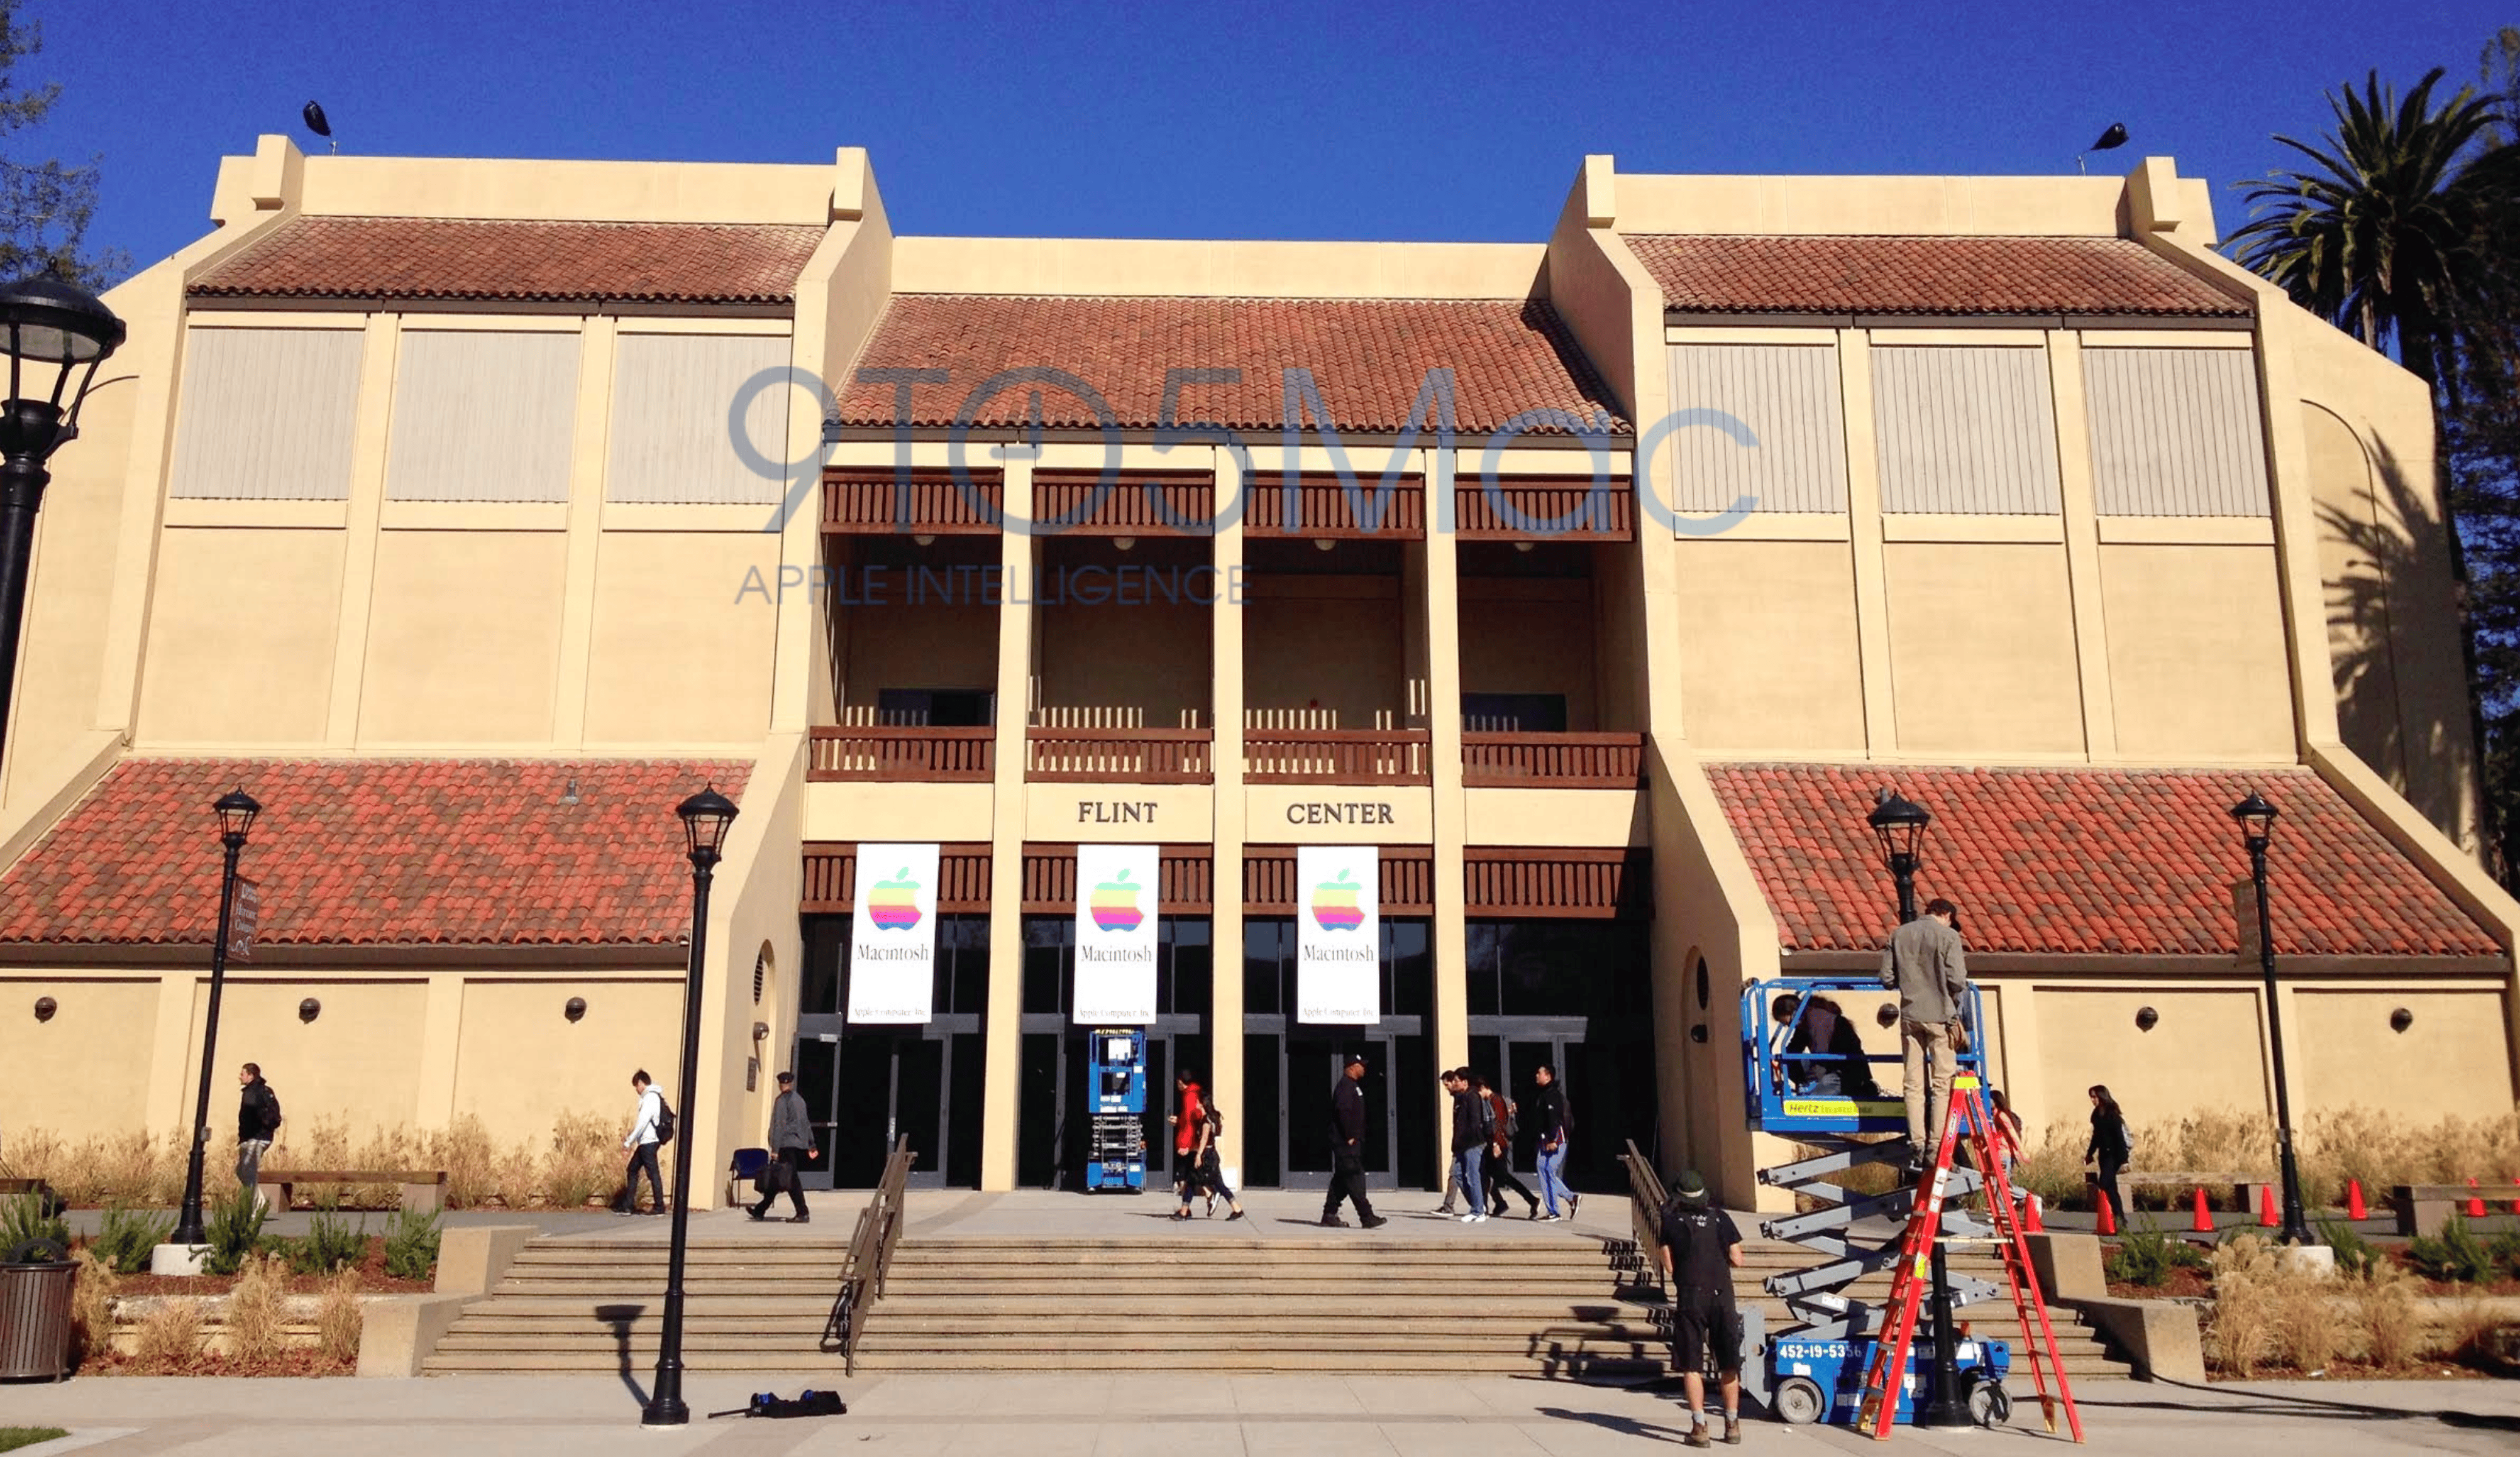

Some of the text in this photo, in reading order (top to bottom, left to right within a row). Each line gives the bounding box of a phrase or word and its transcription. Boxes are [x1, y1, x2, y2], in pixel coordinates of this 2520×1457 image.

[1078, 801, 1395, 825] FLINT CENTER
[857, 943, 928, 960] Macintosh
[1080, 945, 1152, 962] Macintosh
[1303, 944, 1374, 962] Macintosh
[1789, 1103, 1819, 1113] Hertz
